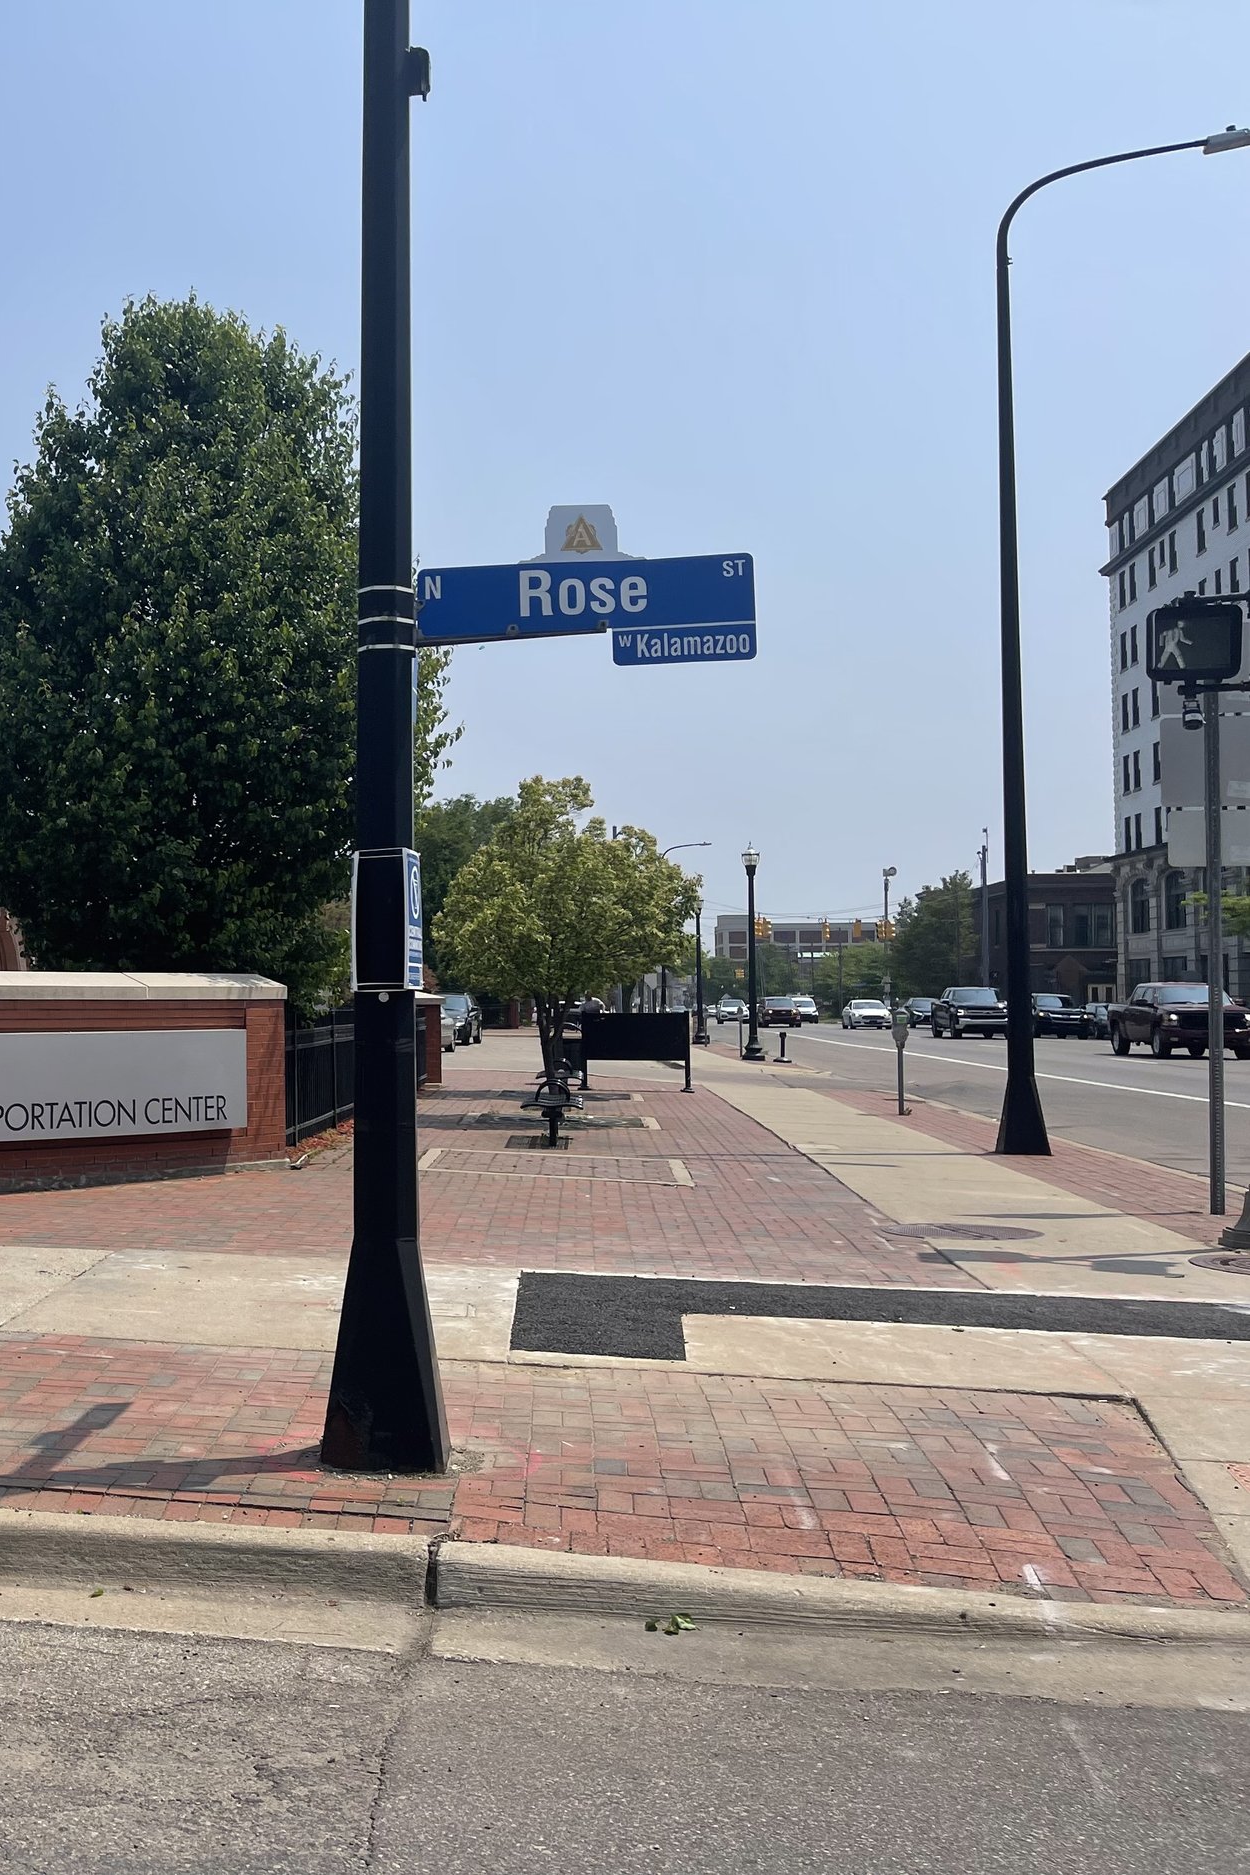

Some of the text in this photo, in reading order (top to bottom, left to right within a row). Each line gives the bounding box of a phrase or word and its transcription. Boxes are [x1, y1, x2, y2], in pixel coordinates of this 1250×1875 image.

[424, 559, 746, 617] N Rose ST
[636, 632, 751, 659] Kalamazoo
[144, 1095, 228, 1125] CENTER
